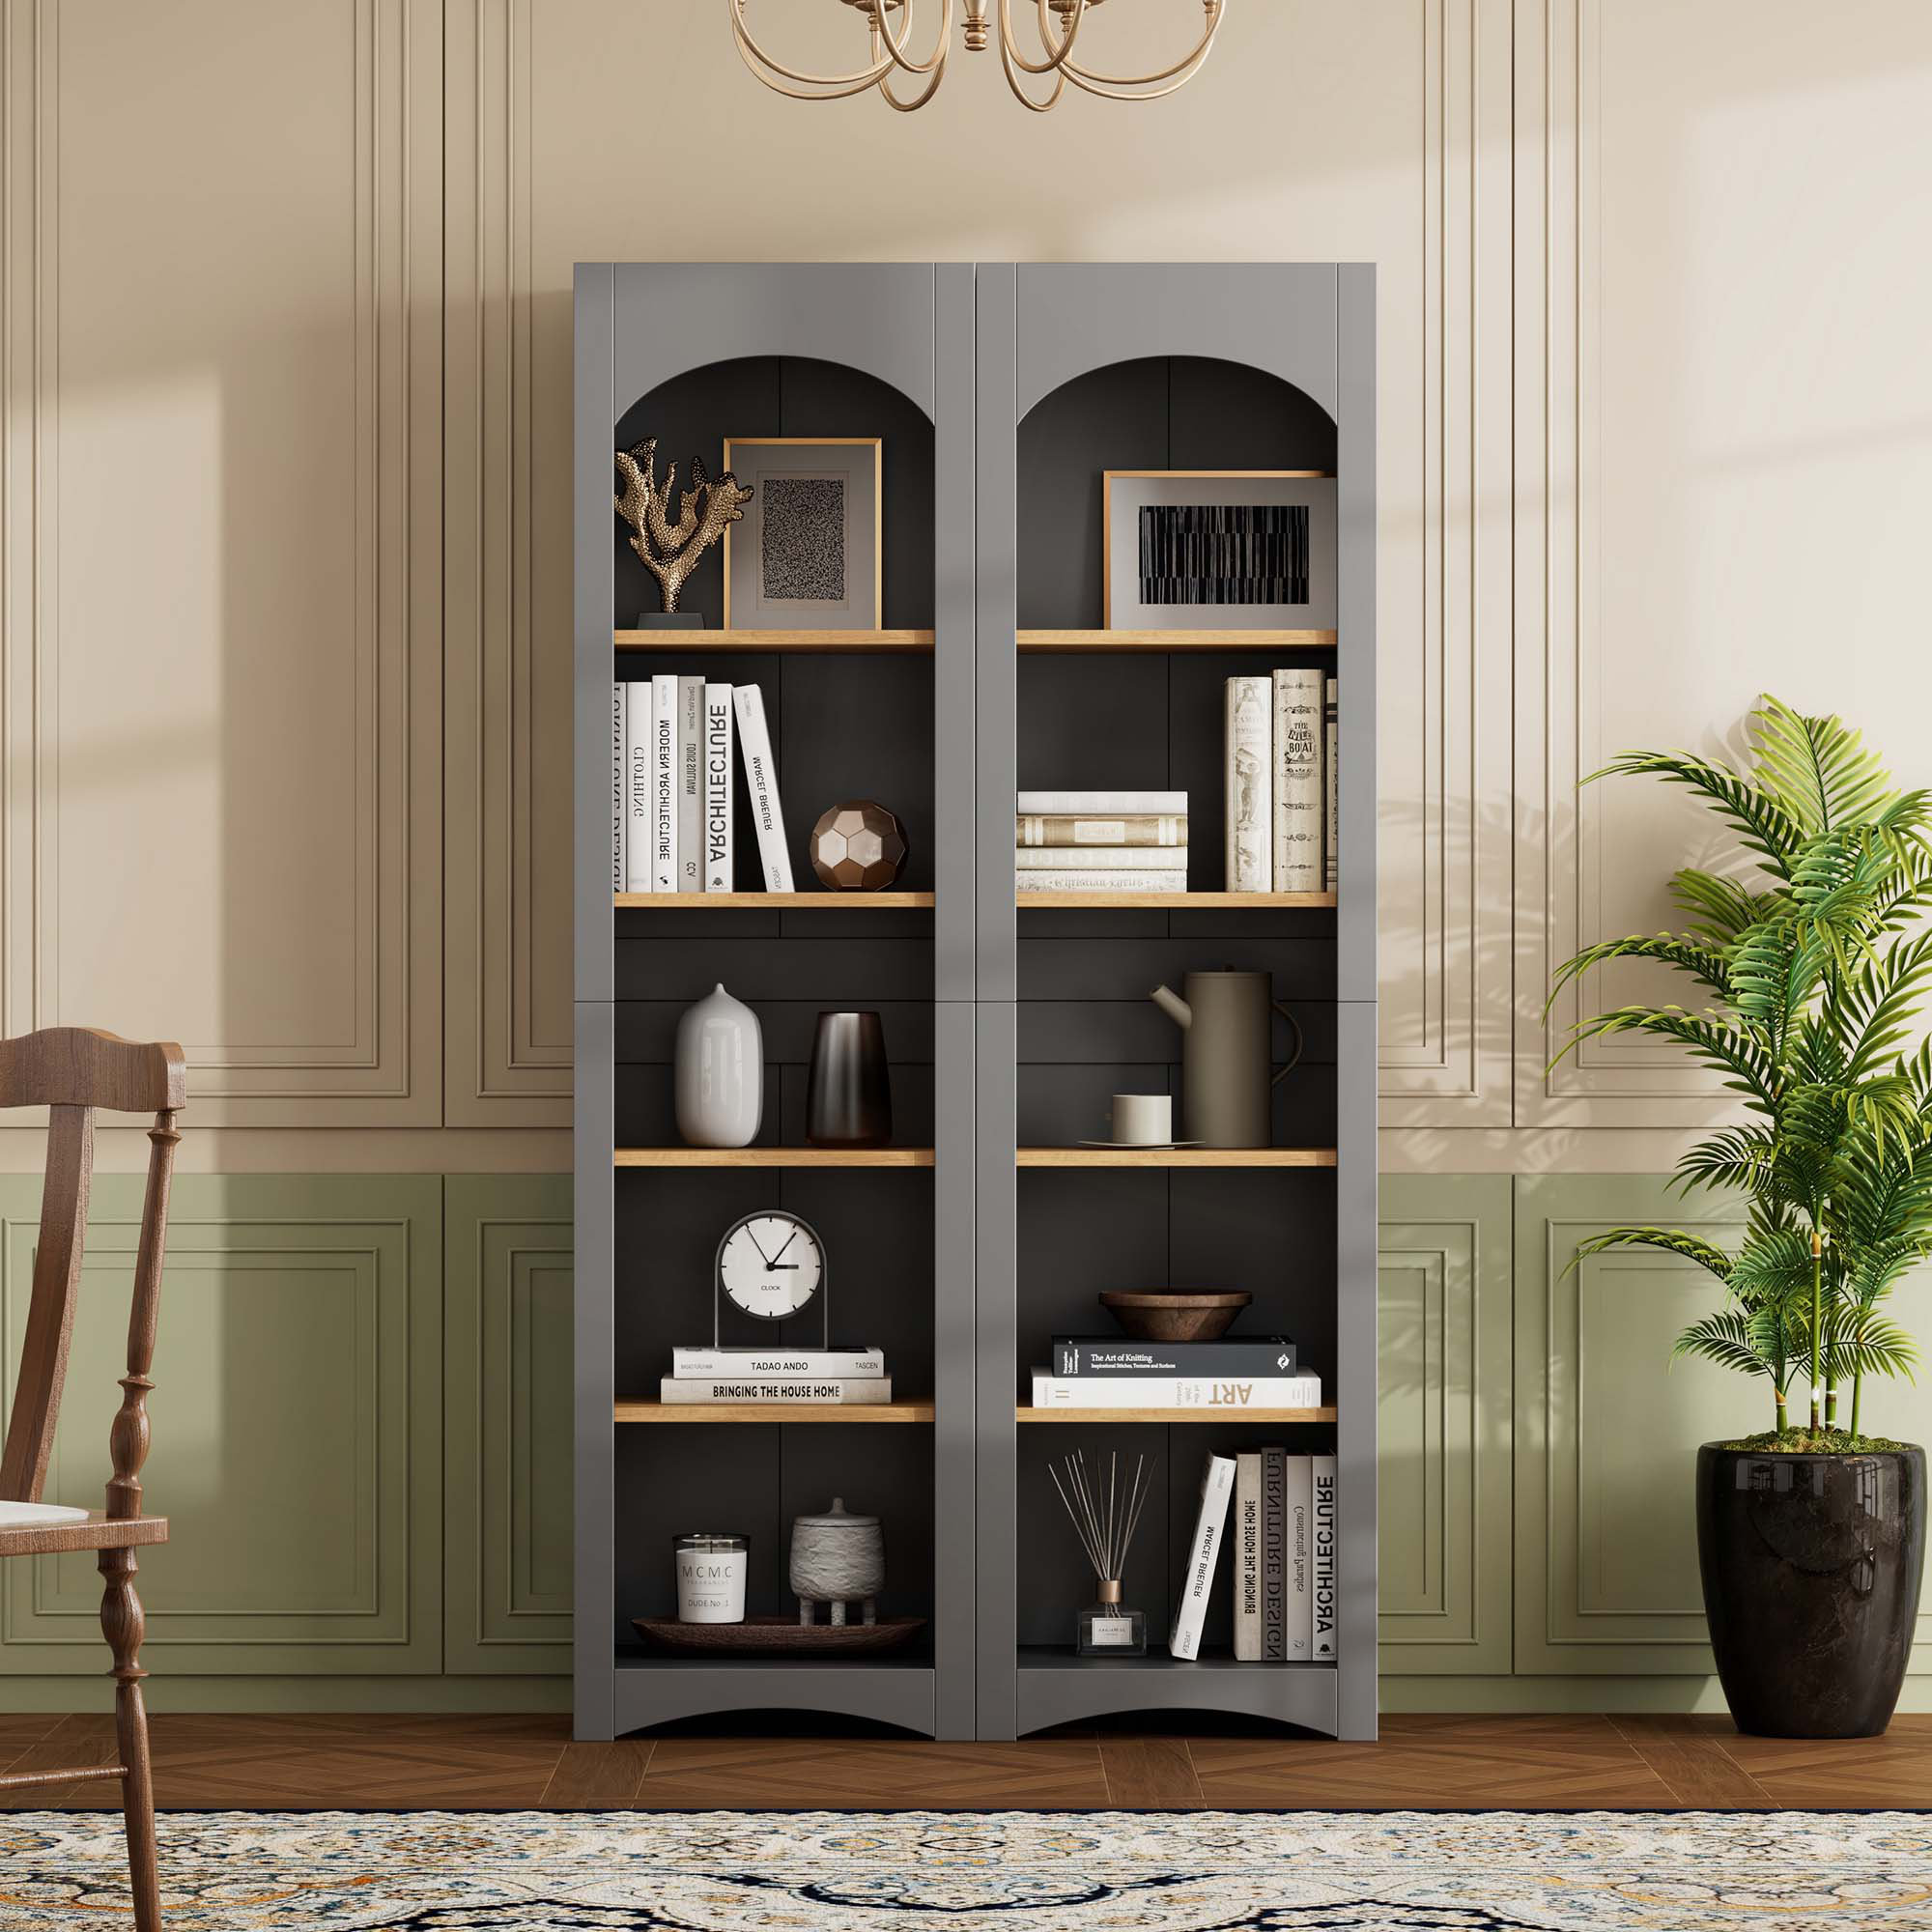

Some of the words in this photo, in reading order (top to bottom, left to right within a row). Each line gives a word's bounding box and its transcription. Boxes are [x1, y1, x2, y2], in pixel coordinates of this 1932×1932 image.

[1289, 742, 1313, 753] BOAT
[1125, 1354, 1152, 1364] Knitting
[752, 1362, 781, 1371] TADAO
[783, 1362, 809, 1371] ANDO
[713, 1386, 757, 1398] BRINGING
[760, 1386, 779, 1398] THE
[781, 1386, 811, 1398] HOUSE
[814, 1386, 840, 1398] HOME
[1208, 1383, 1253, 1405] ART
